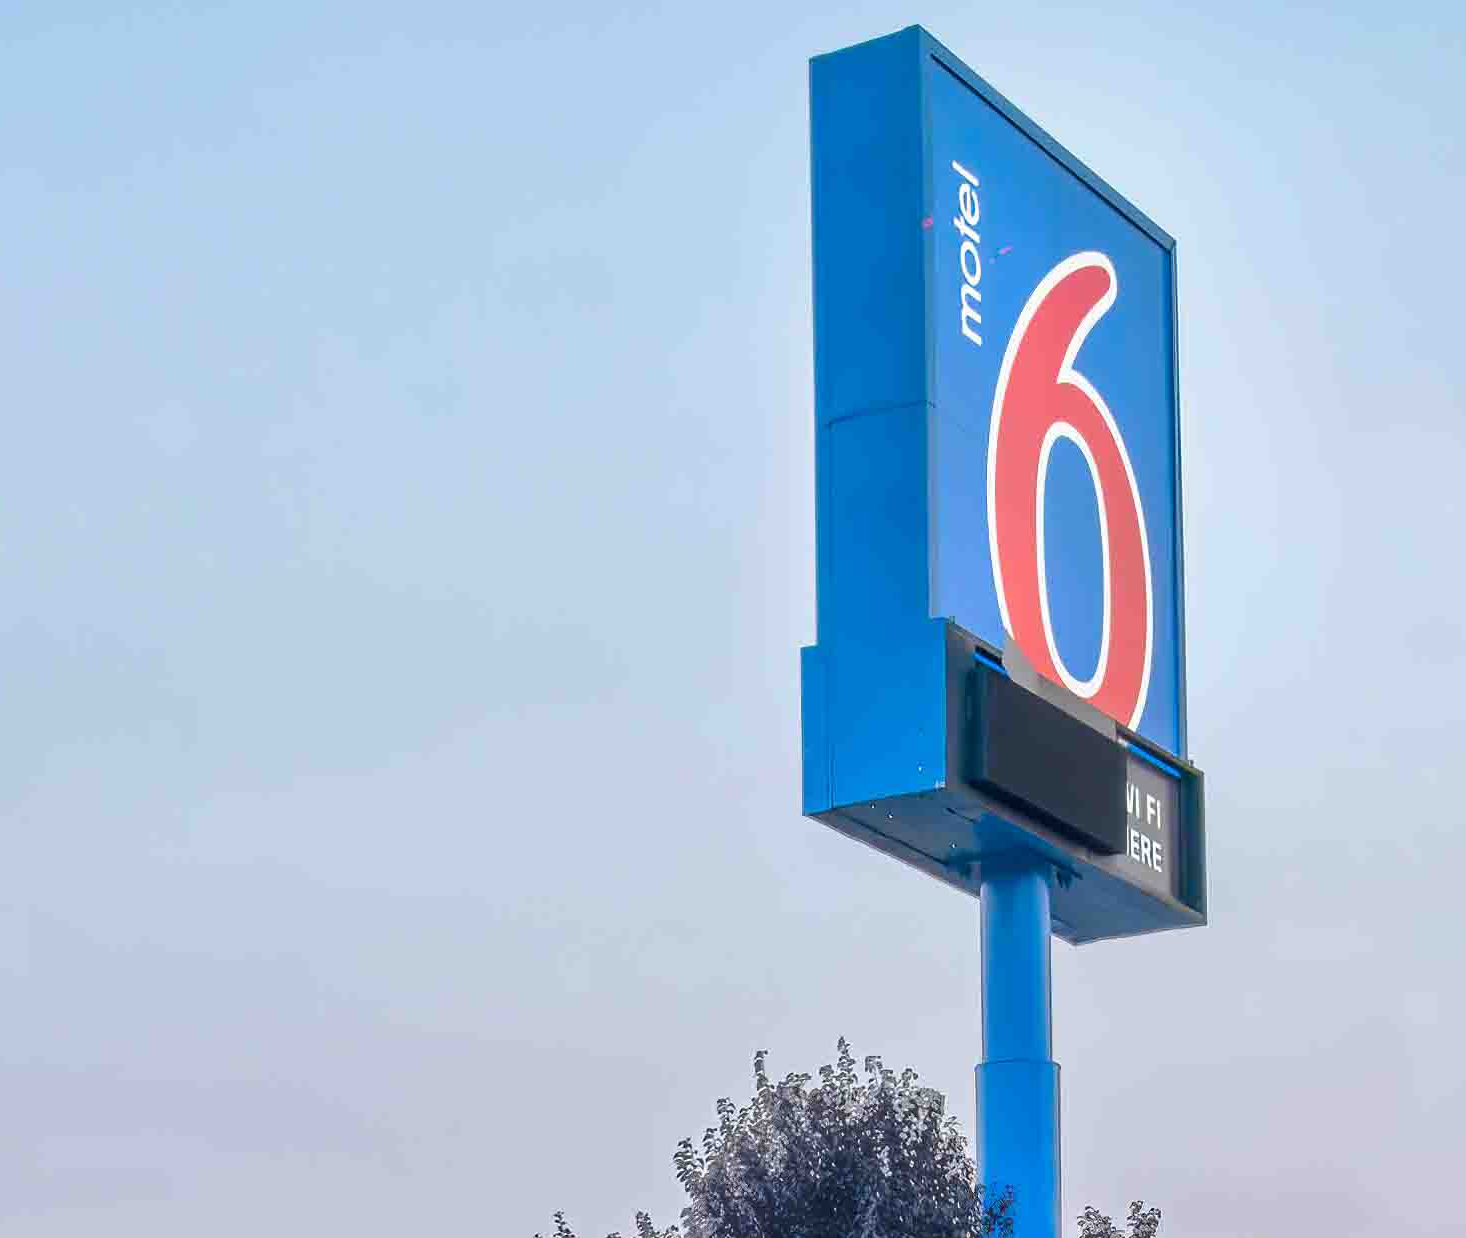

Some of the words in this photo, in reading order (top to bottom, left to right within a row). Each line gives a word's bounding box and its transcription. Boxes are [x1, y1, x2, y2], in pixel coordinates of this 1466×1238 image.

[951, 160, 982, 347] motel
[986, 250, 1153, 732] 6
[1146, 793, 1162, 830] FI
